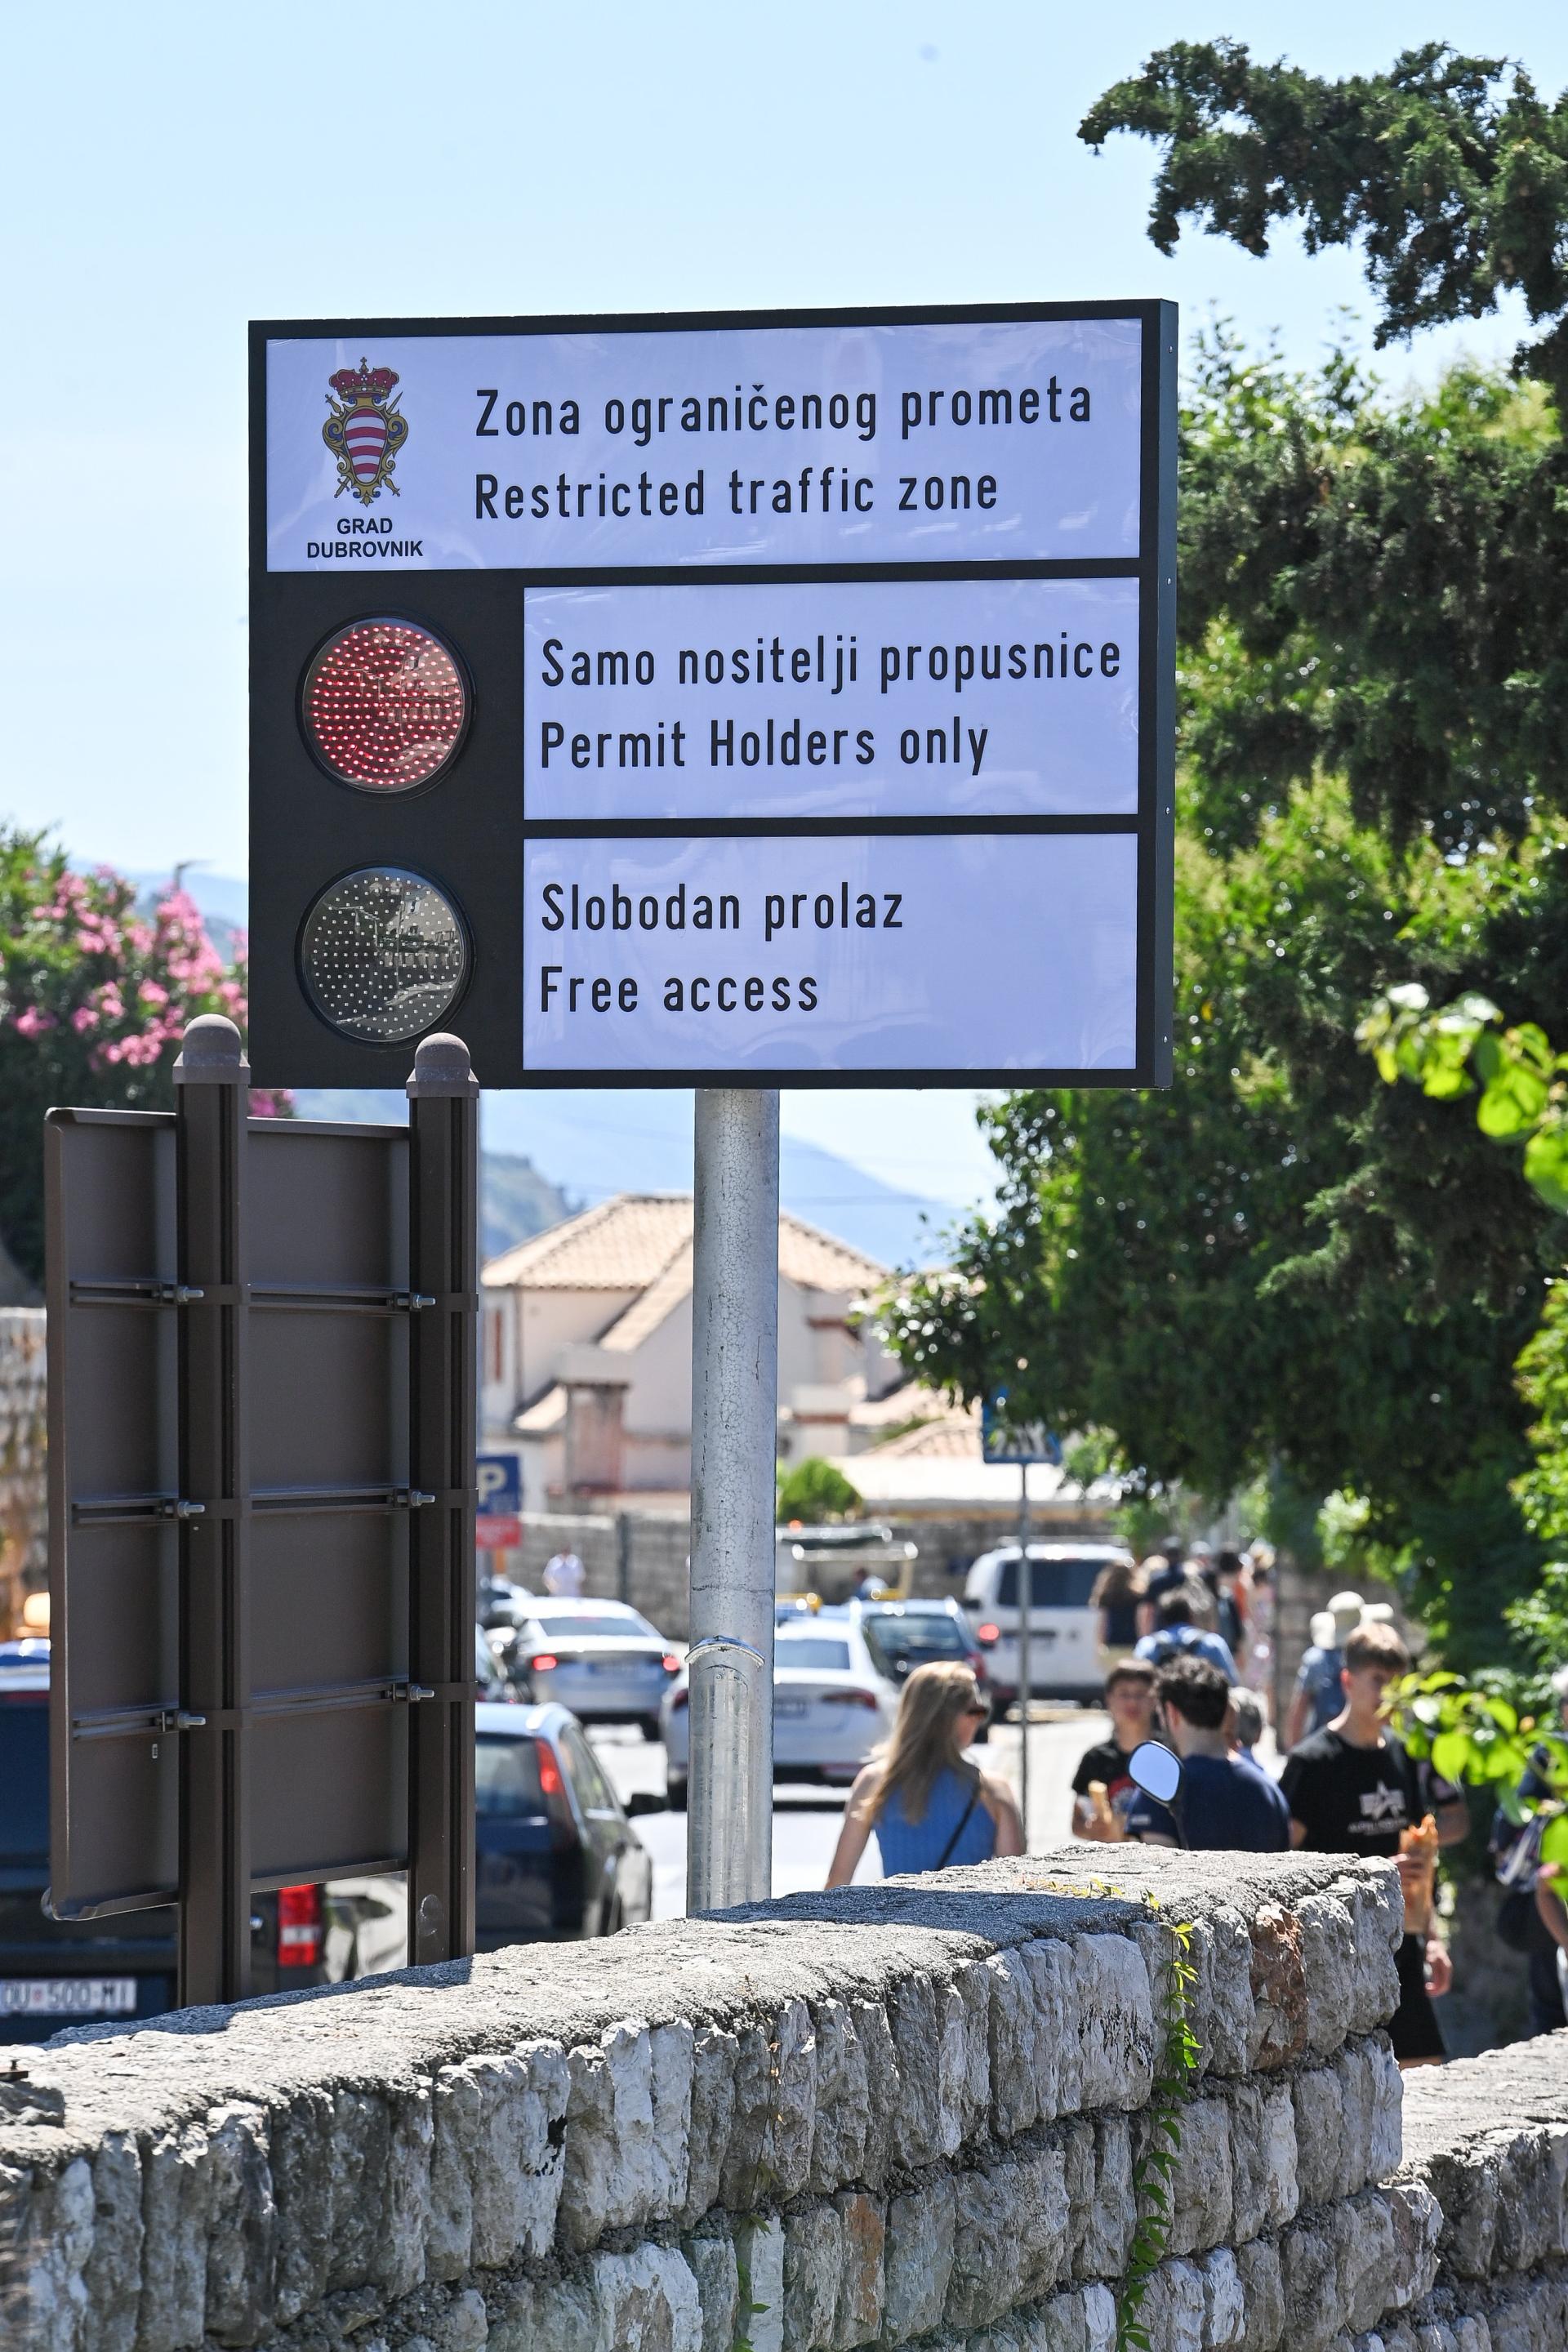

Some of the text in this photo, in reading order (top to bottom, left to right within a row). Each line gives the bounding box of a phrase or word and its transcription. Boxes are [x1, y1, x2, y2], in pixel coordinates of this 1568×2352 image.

[475, 376, 1090, 448] Zona ograničenog prometa
[475, 466, 997, 519] Restricted traffic zone
[307, 541, 424, 559] DUBROVNIK
[336, 518, 393, 535] GRAD
[541, 631, 1120, 695] Samo nositelji propusnice
[541, 715, 989, 777] Permit Holders only
[541, 881, 903, 942] Slobodan prolaz
[541, 965, 817, 1013] Free access
[476, 1463, 507, 1504] P
